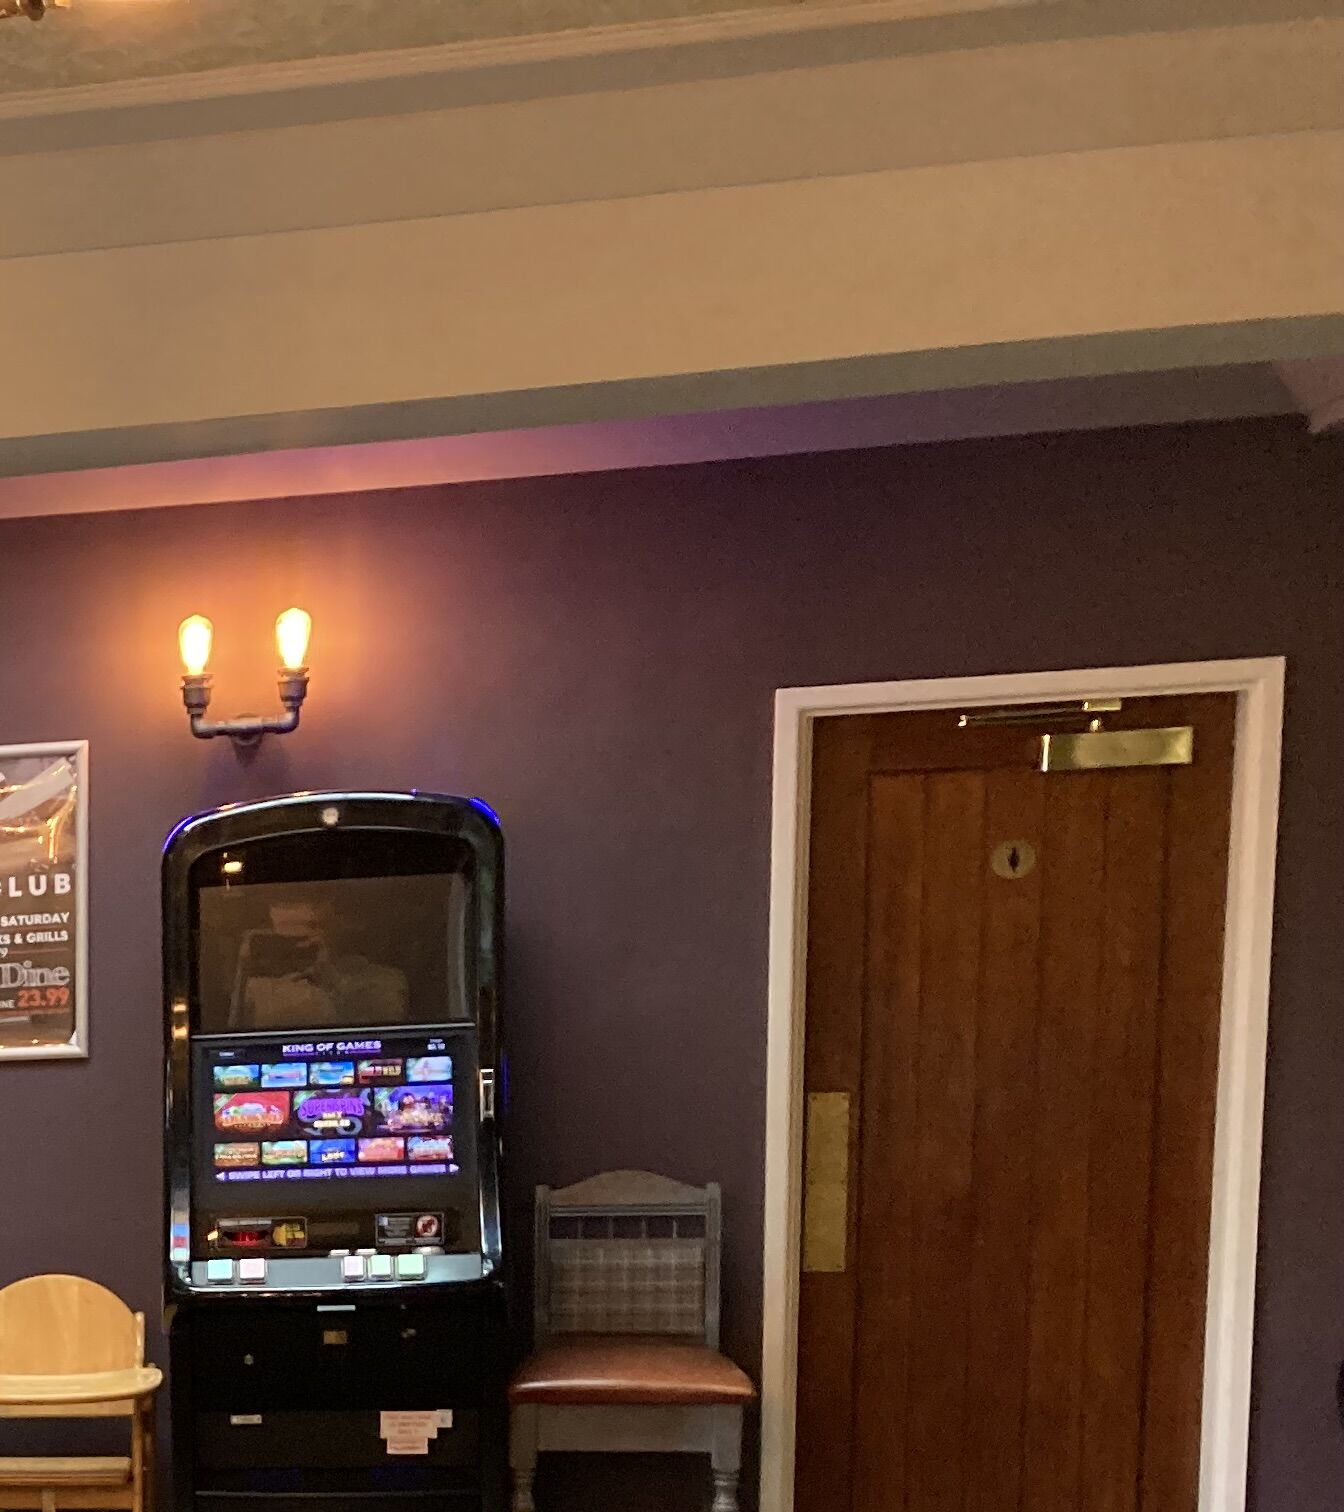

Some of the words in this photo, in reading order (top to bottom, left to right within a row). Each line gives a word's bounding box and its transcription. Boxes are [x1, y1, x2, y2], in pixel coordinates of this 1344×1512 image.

[0, 911, 70, 927] SATURDAY
[14, 932, 23, 944] &
[26, 930, 69, 943] GRILLS
[17, 987, 70, 1009] 23.99
[282, 1043, 314, 1055] KING
[315, 1042, 334, 1053] OF
[336, 1040, 382, 1052] GAMES
[262, 1169, 286, 1180] LEFT
[286, 1169, 302, 1179] OR
[334, 1167, 347, 1177] TO
[348, 1166, 375, 1177] VIEW
